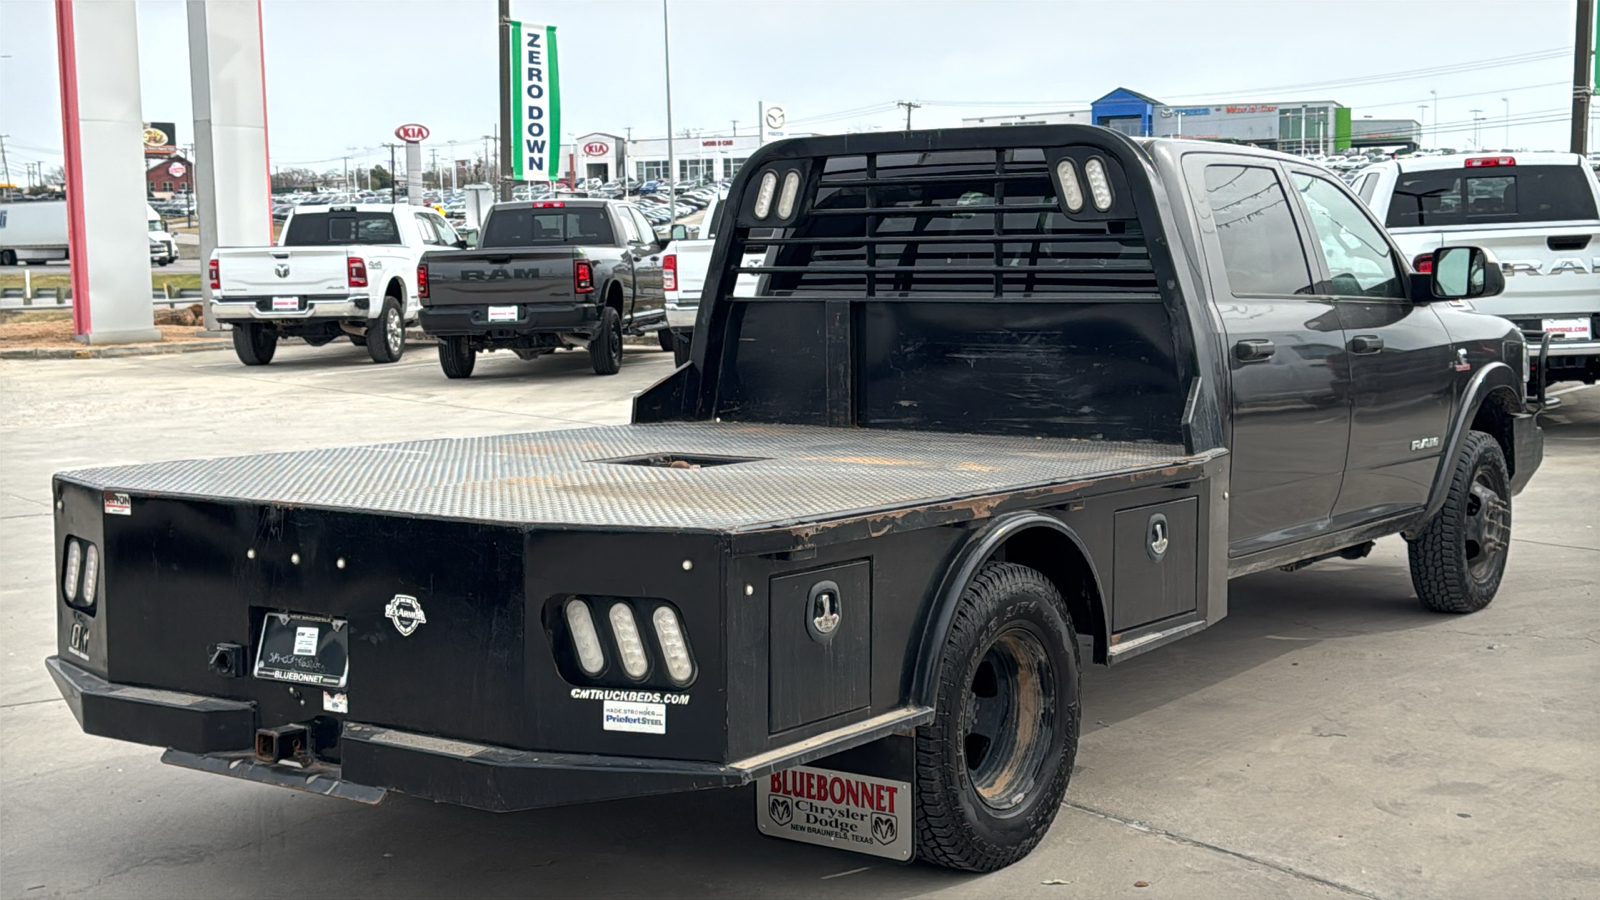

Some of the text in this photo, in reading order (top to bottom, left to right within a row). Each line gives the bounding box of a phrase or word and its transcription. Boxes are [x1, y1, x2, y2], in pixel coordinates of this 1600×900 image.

[526, 32, 546, 171] ZERO DOWN
[402, 127, 425, 139] KIA
[586, 144, 606, 154] KIA
[460, 268, 540, 281] RAM
[1501, 258, 1600, 277] RA
[274, 670, 323, 683] BLUEBONNET
[571, 688, 690, 705] CMTRUCKBEDS.COM
[771, 769, 898, 813] BLUEBONNET
[795, 800, 868, 822] Chrysler
[805, 813, 858, 833] Dodge
[790, 823, 806, 832] NEW
[851, 834, 874, 845] TEXAS
